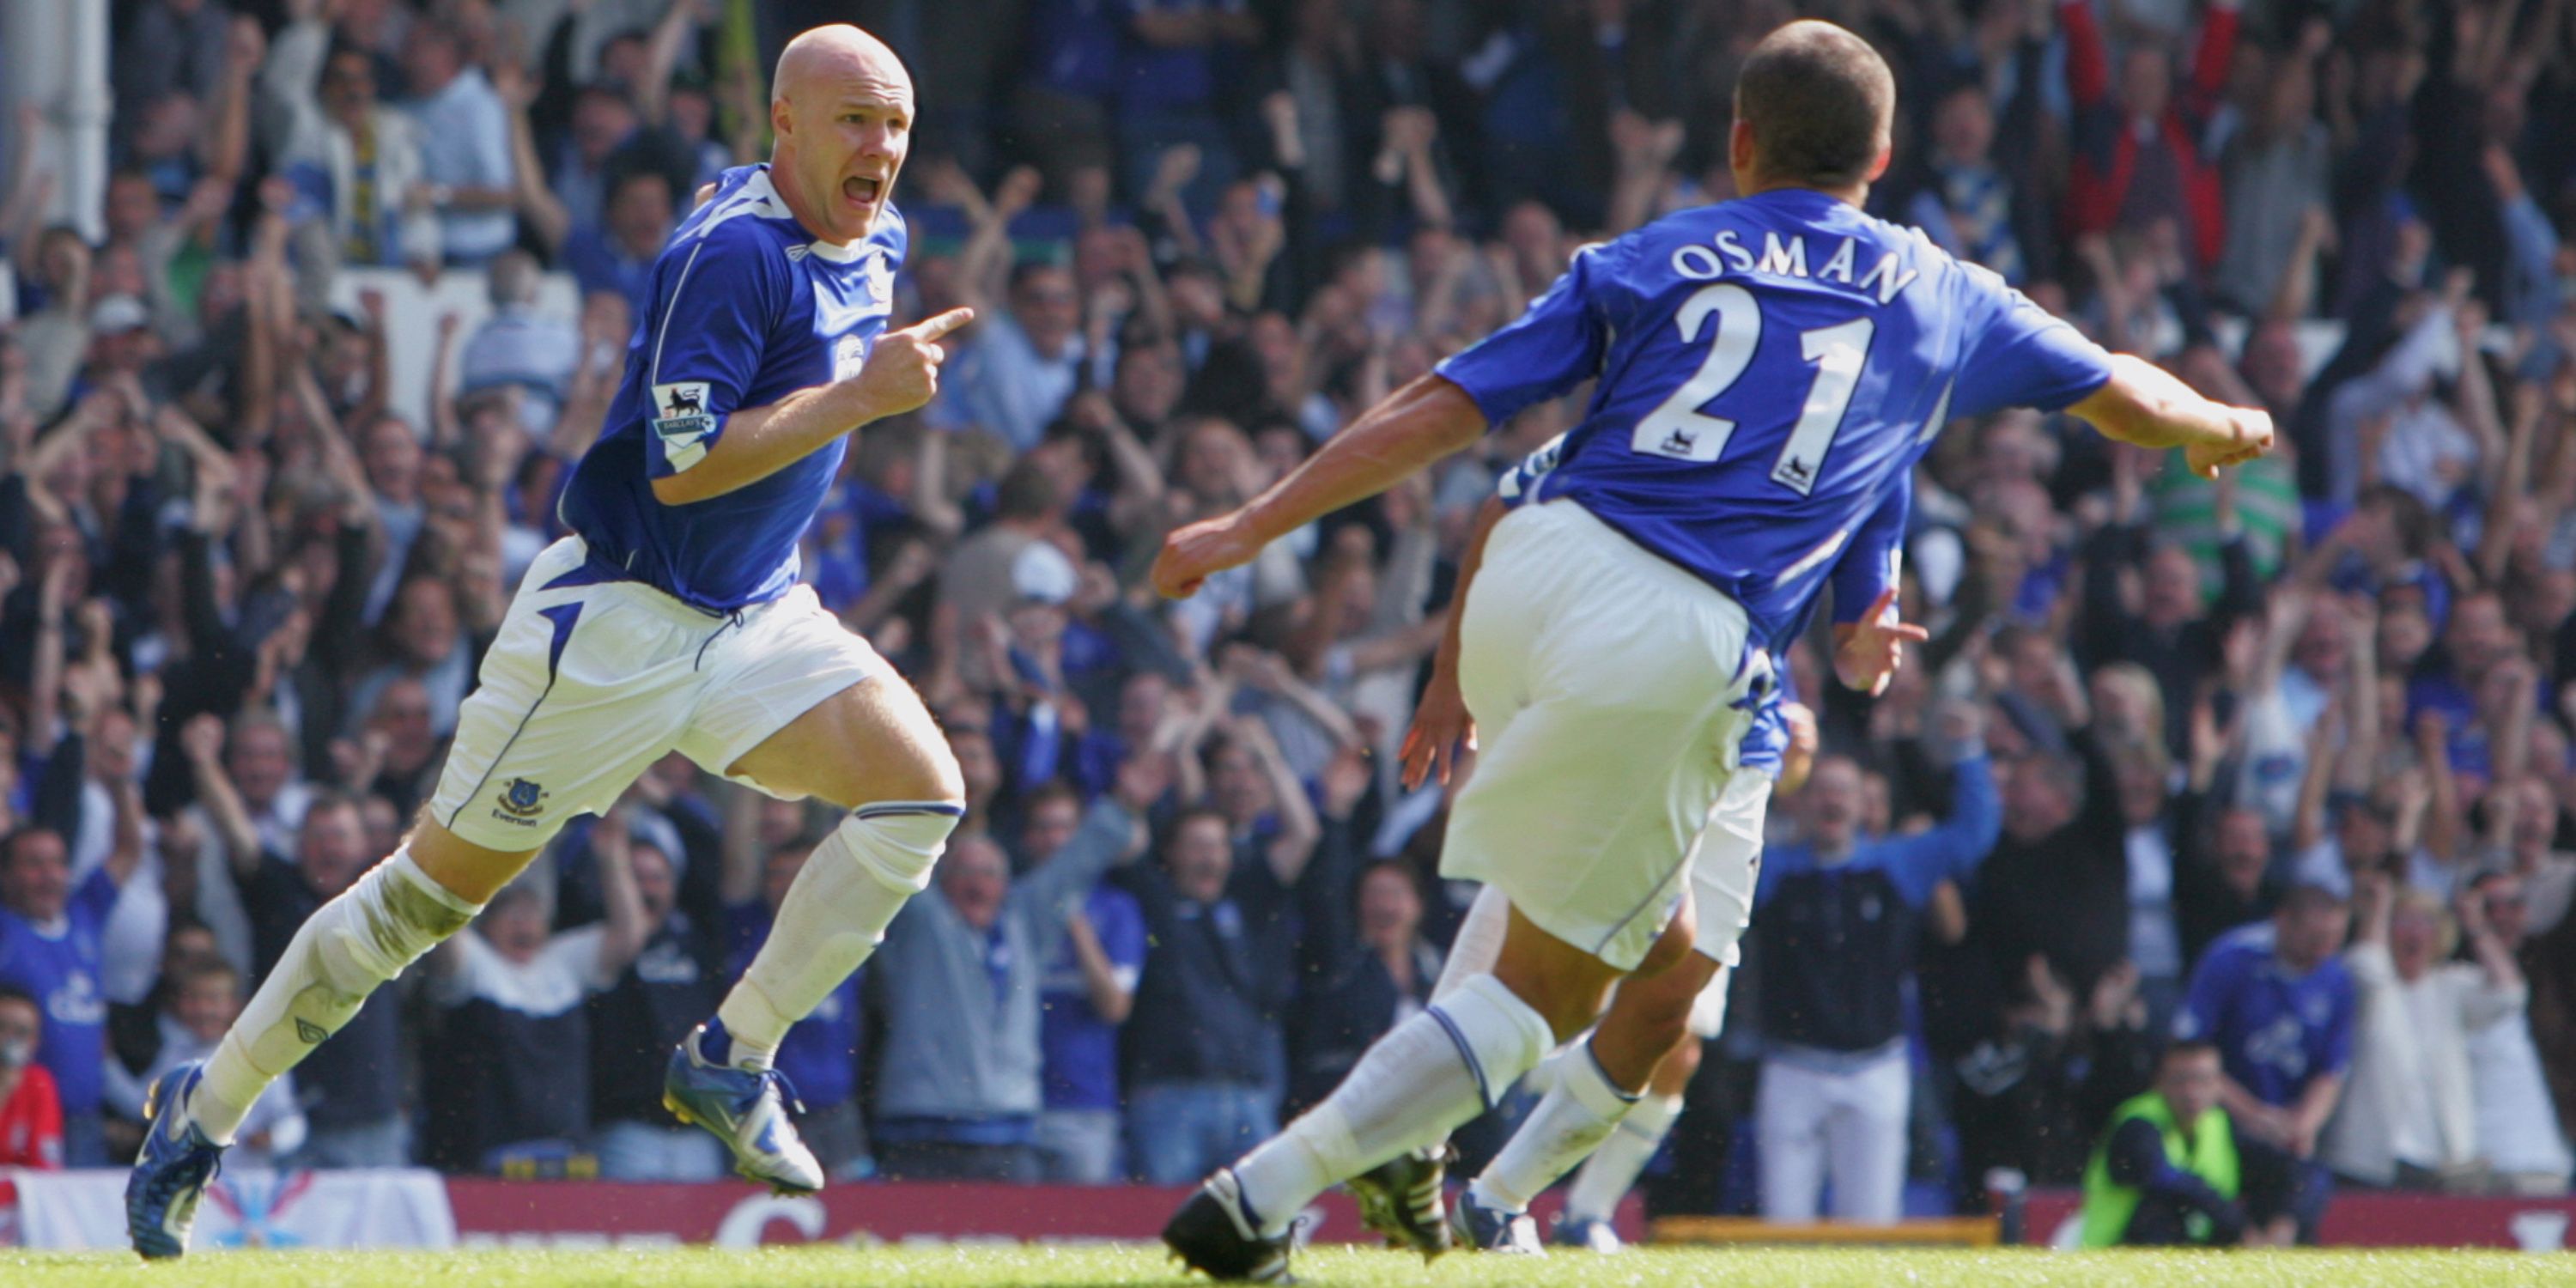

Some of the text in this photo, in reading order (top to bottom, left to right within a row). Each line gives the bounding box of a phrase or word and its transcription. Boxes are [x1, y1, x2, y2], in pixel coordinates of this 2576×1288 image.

[1672, 231, 1918, 304] OSMAN
[1632, 283, 1874, 495] 21
[492, 809, 537, 827] Everton
